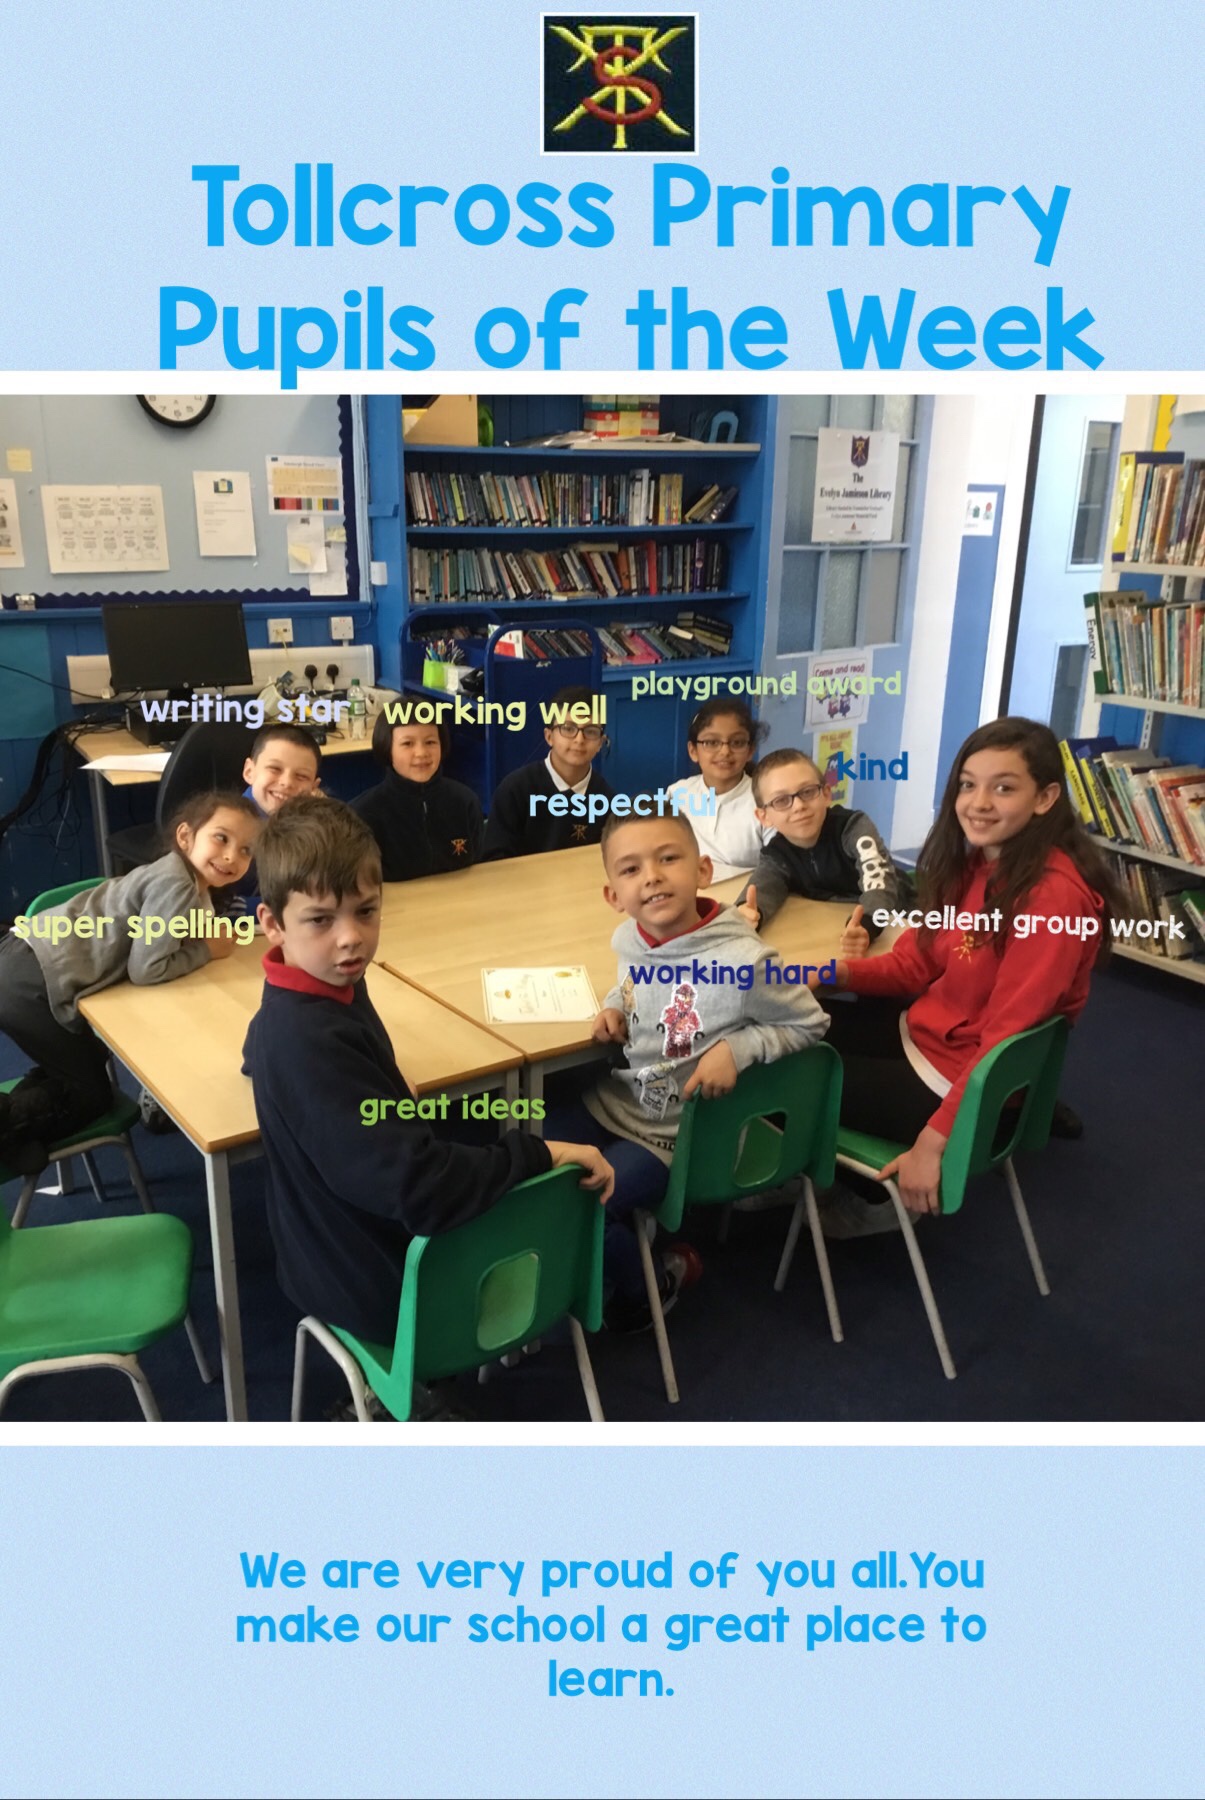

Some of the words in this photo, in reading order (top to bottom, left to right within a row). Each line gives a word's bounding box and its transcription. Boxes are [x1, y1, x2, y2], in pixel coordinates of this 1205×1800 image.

[852, 472, 864, 484] The
[820, 488, 840, 500] Evelyn
[870, 488, 892, 502] Library
[815, 668, 833, 677] Come
[834, 664, 849, 674] and
[850, 662, 865, 673] read
